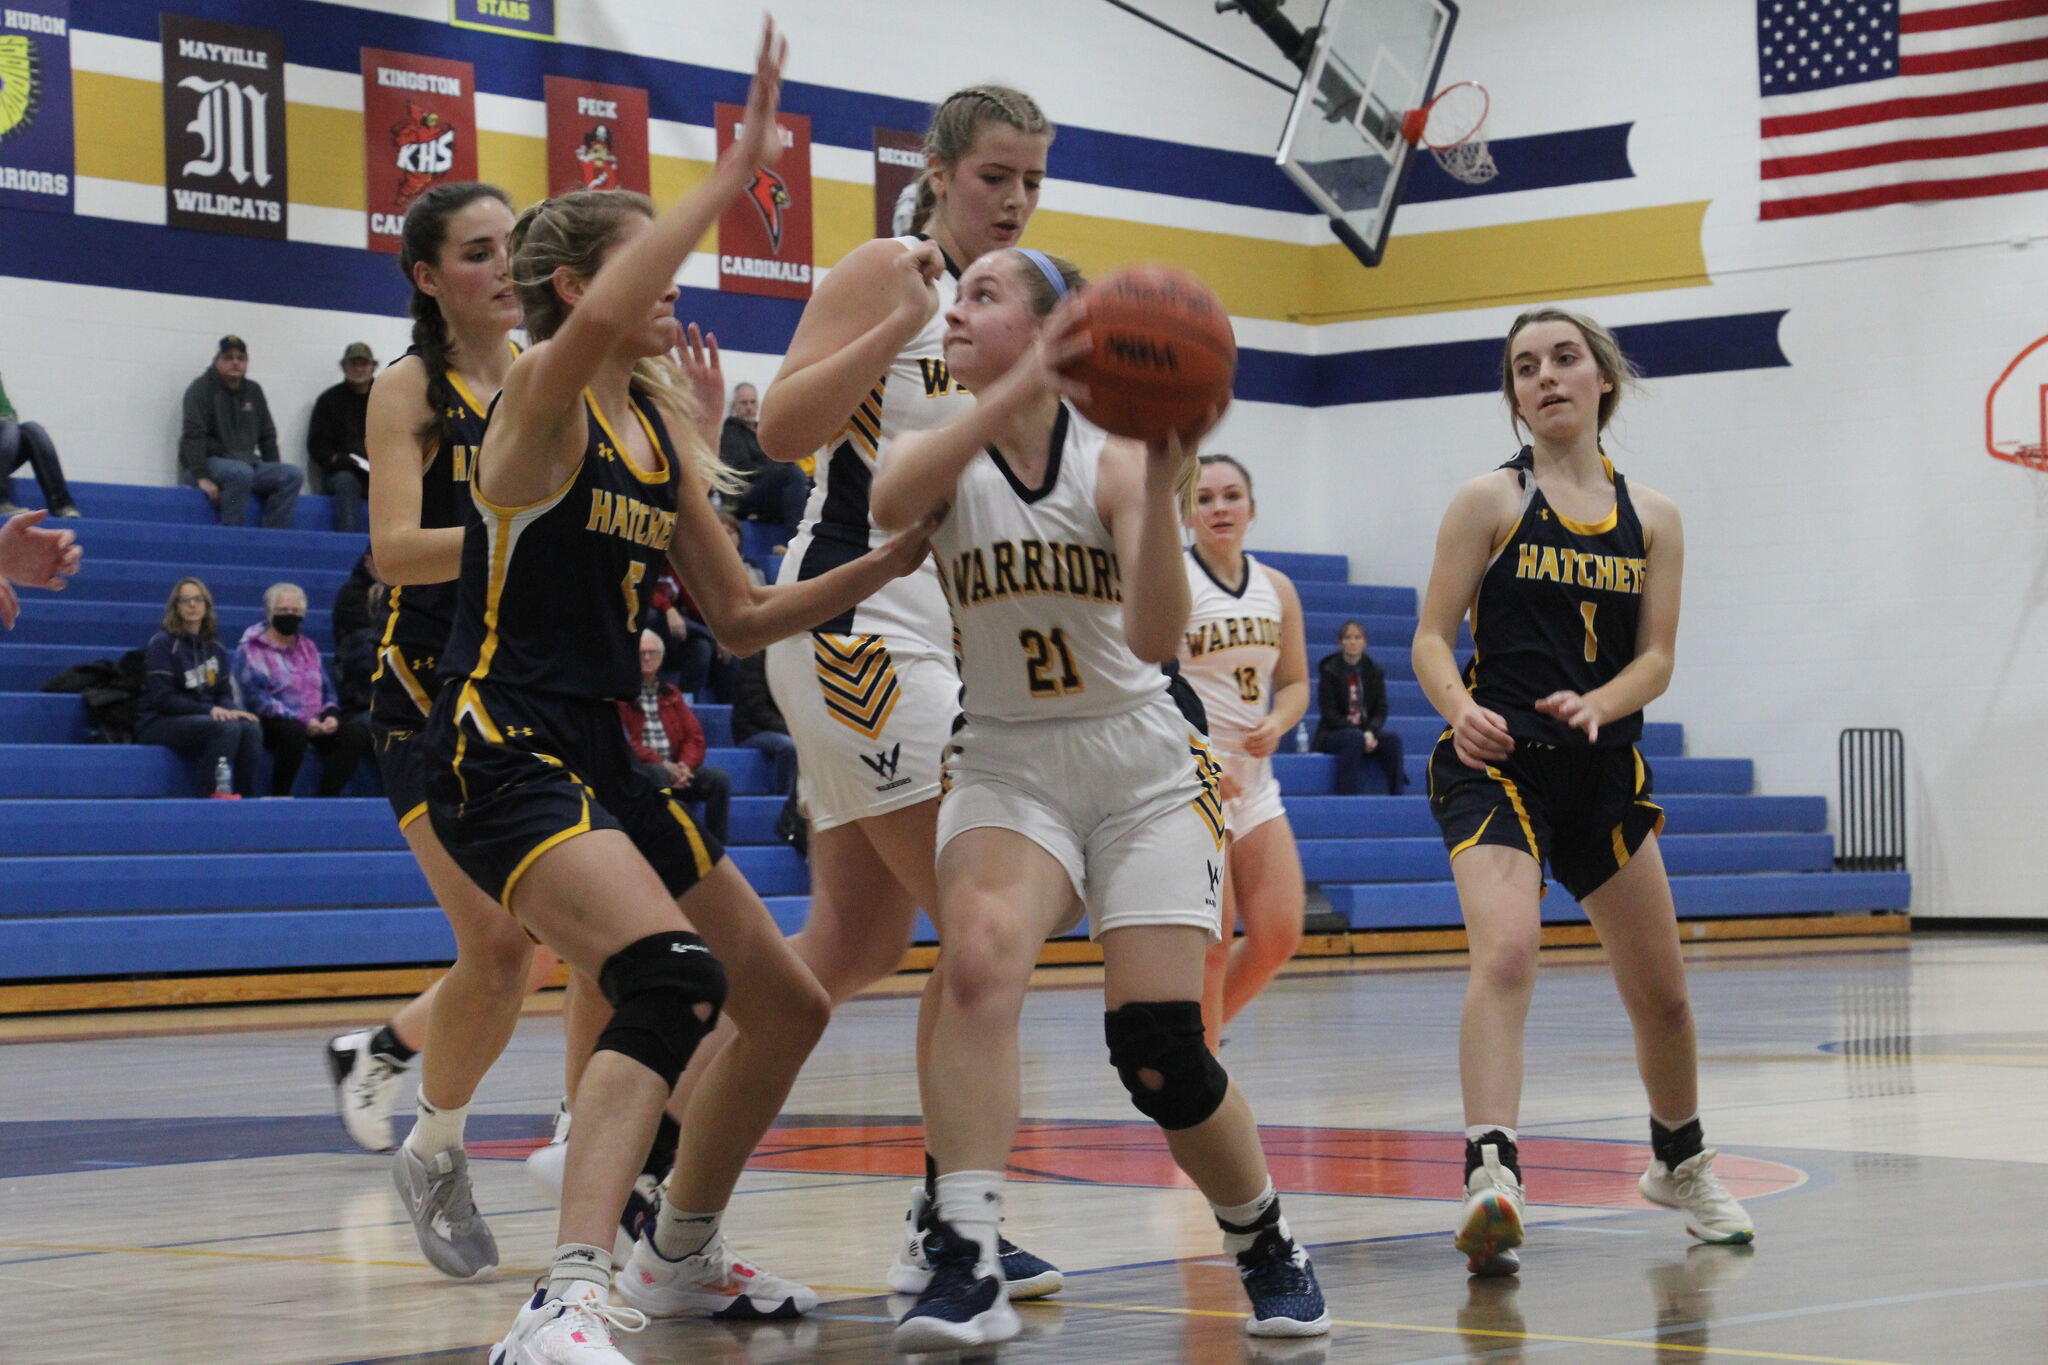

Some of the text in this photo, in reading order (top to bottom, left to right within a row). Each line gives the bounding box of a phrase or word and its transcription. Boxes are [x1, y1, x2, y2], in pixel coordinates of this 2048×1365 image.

[4, 9, 66, 36] HURON
[178, 38, 268, 69] MAYVILLE
[377, 67, 461, 96] KINGSTON
[577, 97, 617, 119] PECK
[397, 130, 455, 173] KHS
[0, 166, 68, 196] RIORS
[174, 189, 280, 222] WILDCATS
[721, 256, 810, 283] CARDINALS
[585, 488, 678, 551] HATCHE
[1580, 601, 1598, 662] 1
[1019, 627, 1085, 698] 21
[1233, 666, 1260, 705] 13
